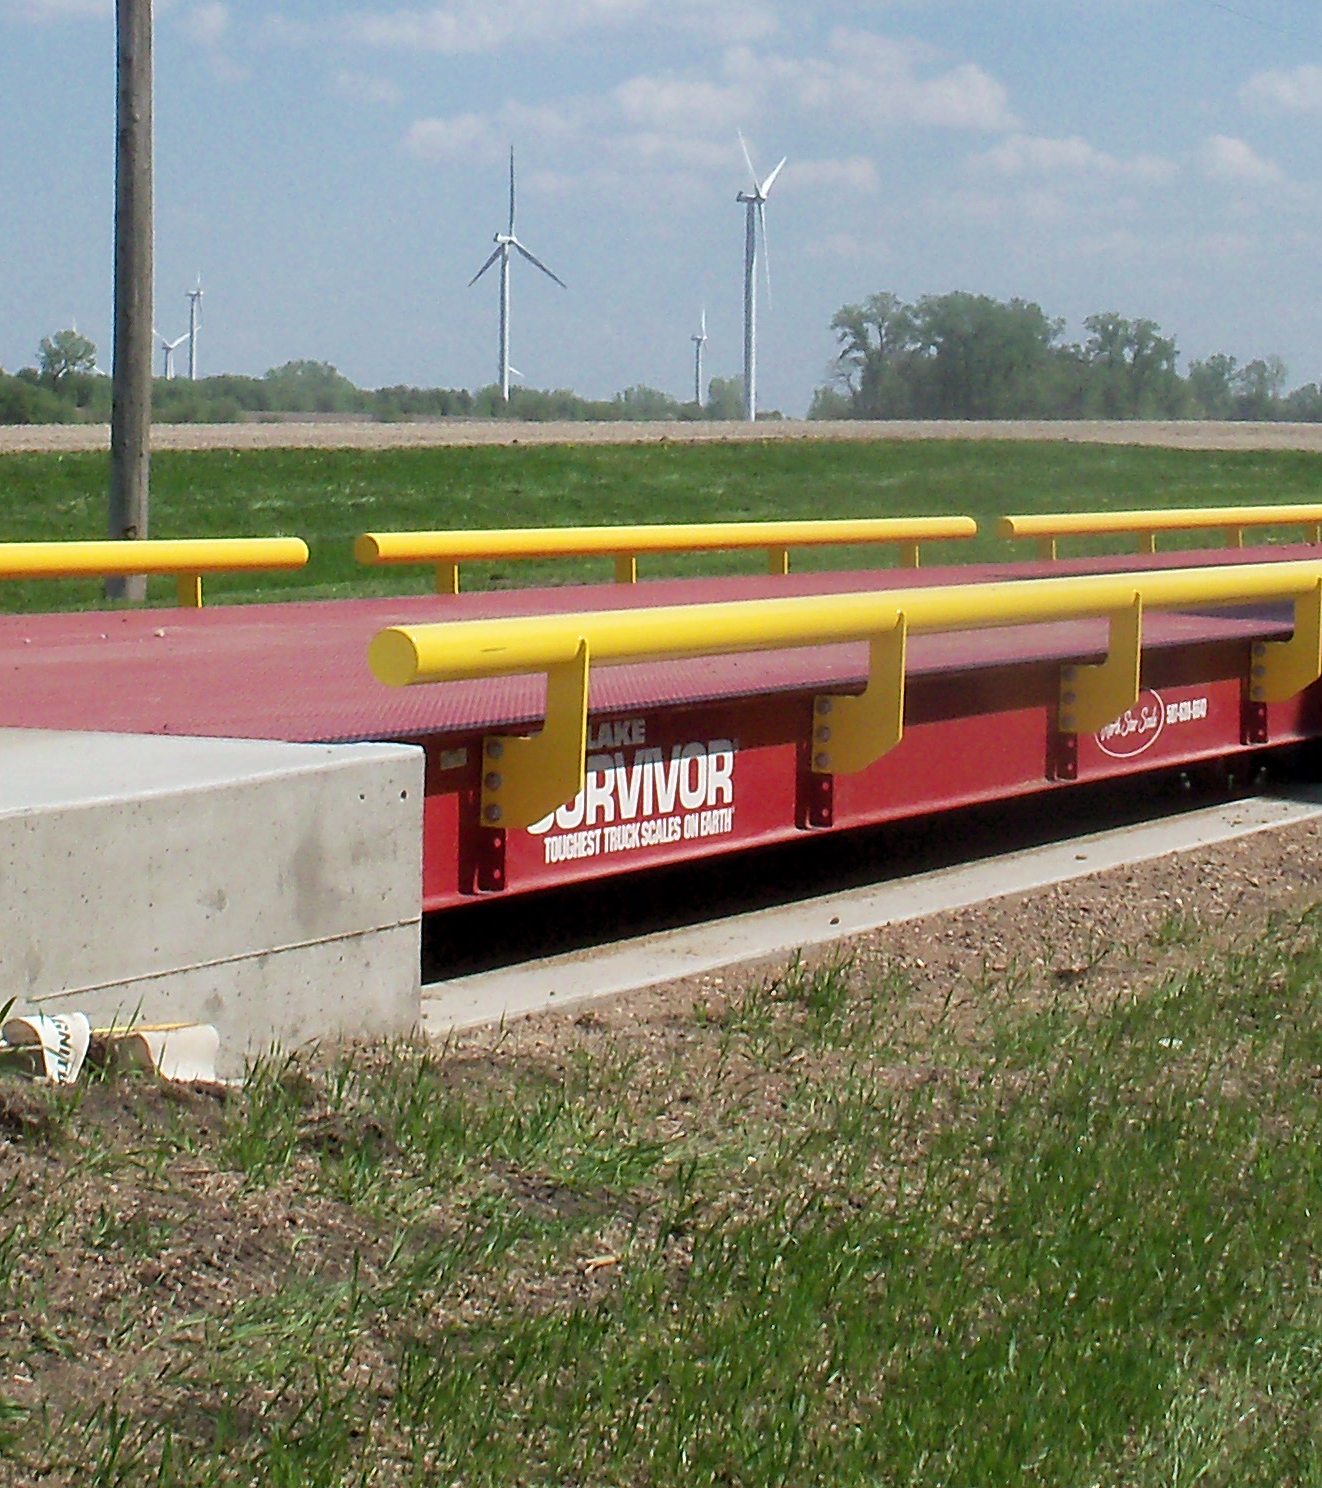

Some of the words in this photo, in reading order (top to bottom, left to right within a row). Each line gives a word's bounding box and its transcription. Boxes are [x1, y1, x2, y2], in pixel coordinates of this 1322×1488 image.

[587, 718, 646, 750] LAKE
[526, 738, 734, 835] RVIVOR
[544, 827, 602, 864] TOUGHEST
[603, 821, 641, 853] TRUCK
[641, 815, 682, 847] SCALES
[683, 811, 699, 840] ON
[700, 807, 733, 836] EARTH
